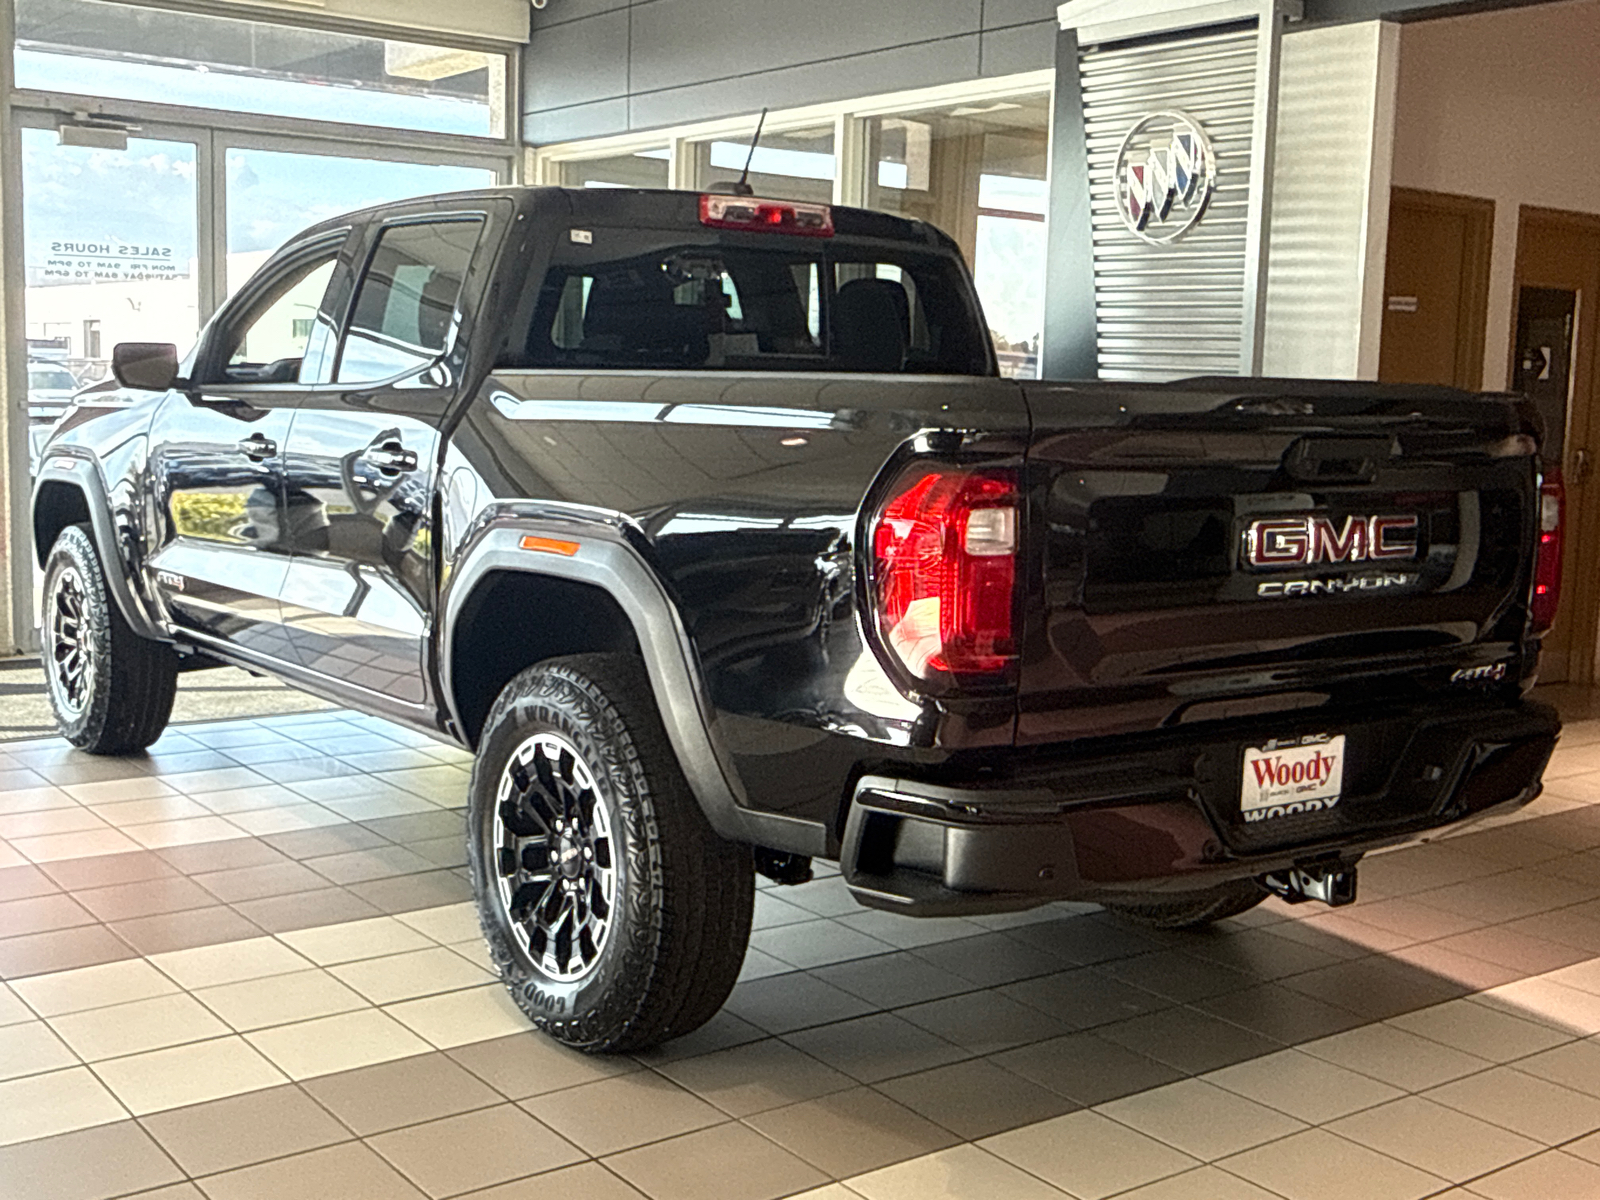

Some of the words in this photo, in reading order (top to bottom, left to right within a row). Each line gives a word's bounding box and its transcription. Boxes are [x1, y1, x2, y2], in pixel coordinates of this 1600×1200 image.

[1249, 514, 1418, 566] GMC
[1257, 573, 1419, 597] CANYON
[1250, 750, 1336, 788] Woody
